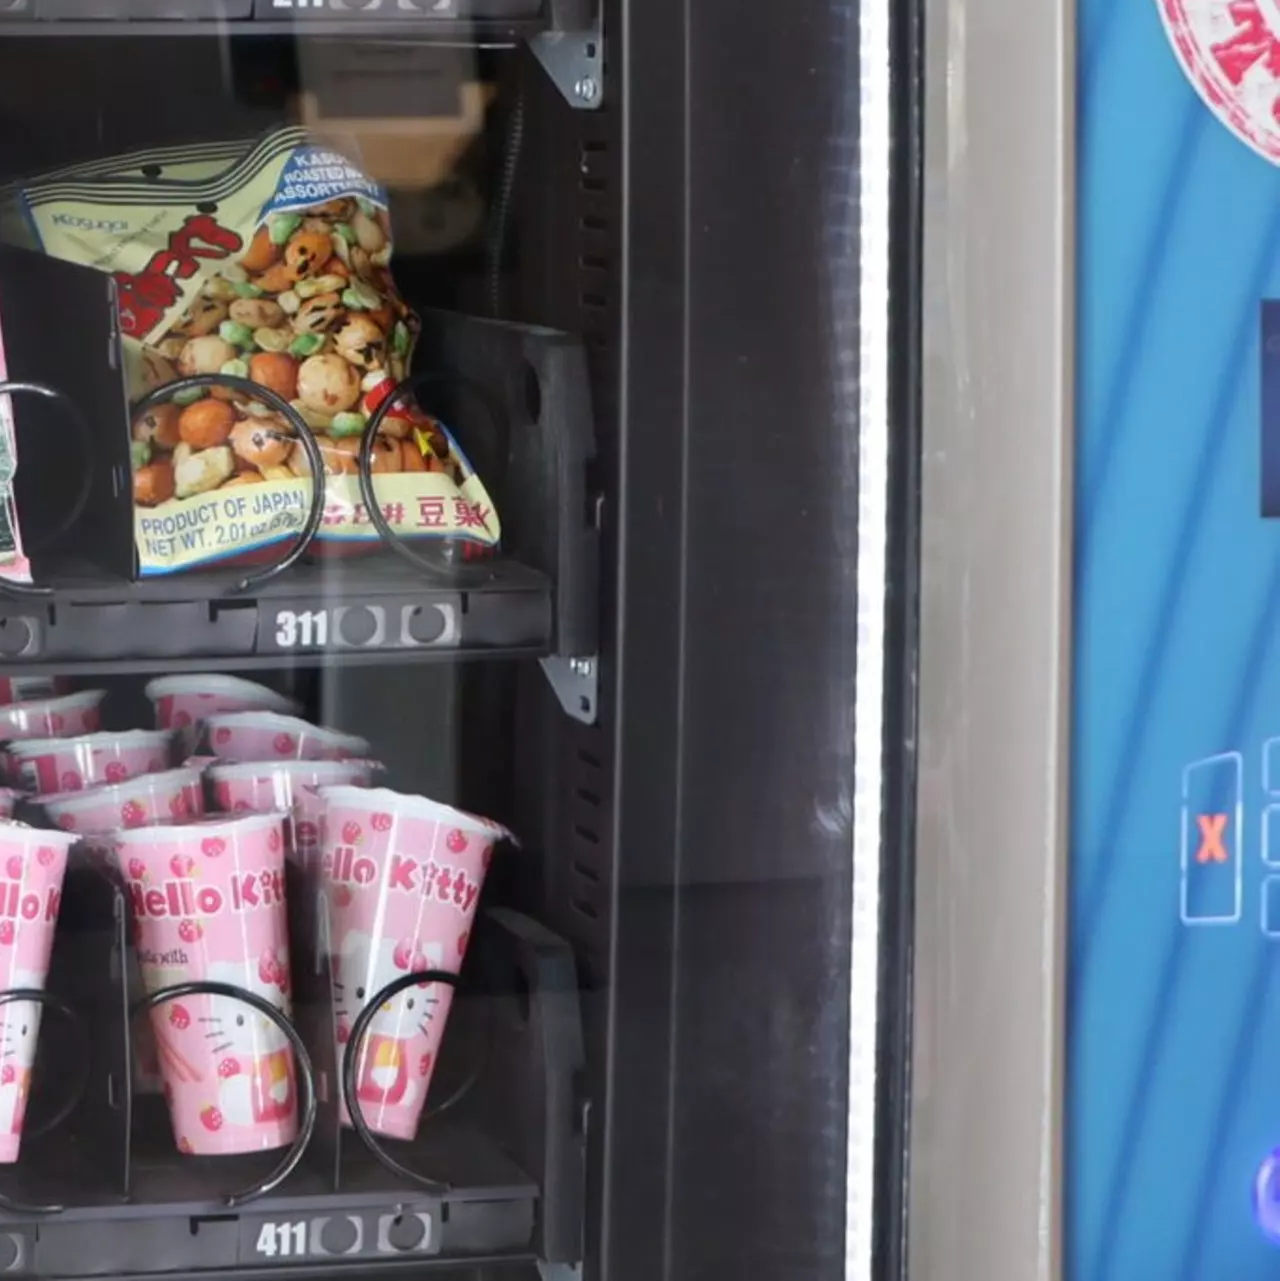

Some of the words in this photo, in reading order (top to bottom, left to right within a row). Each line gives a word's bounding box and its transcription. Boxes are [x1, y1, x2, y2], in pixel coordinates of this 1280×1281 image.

[140, 502, 220, 536] PRODUCT
[223, 496, 247, 519] OF
[252, 489, 305, 516] JAPAN
[145, 537, 177, 557] NET
[180, 528, 213, 550] WT.
[215, 522, 247, 546] 2.01
[275, 610, 328, 646] 311
[387, 854, 478, 912] Kitty
[159, 949, 190, 966] with
[255, 1221, 307, 1257] 411
